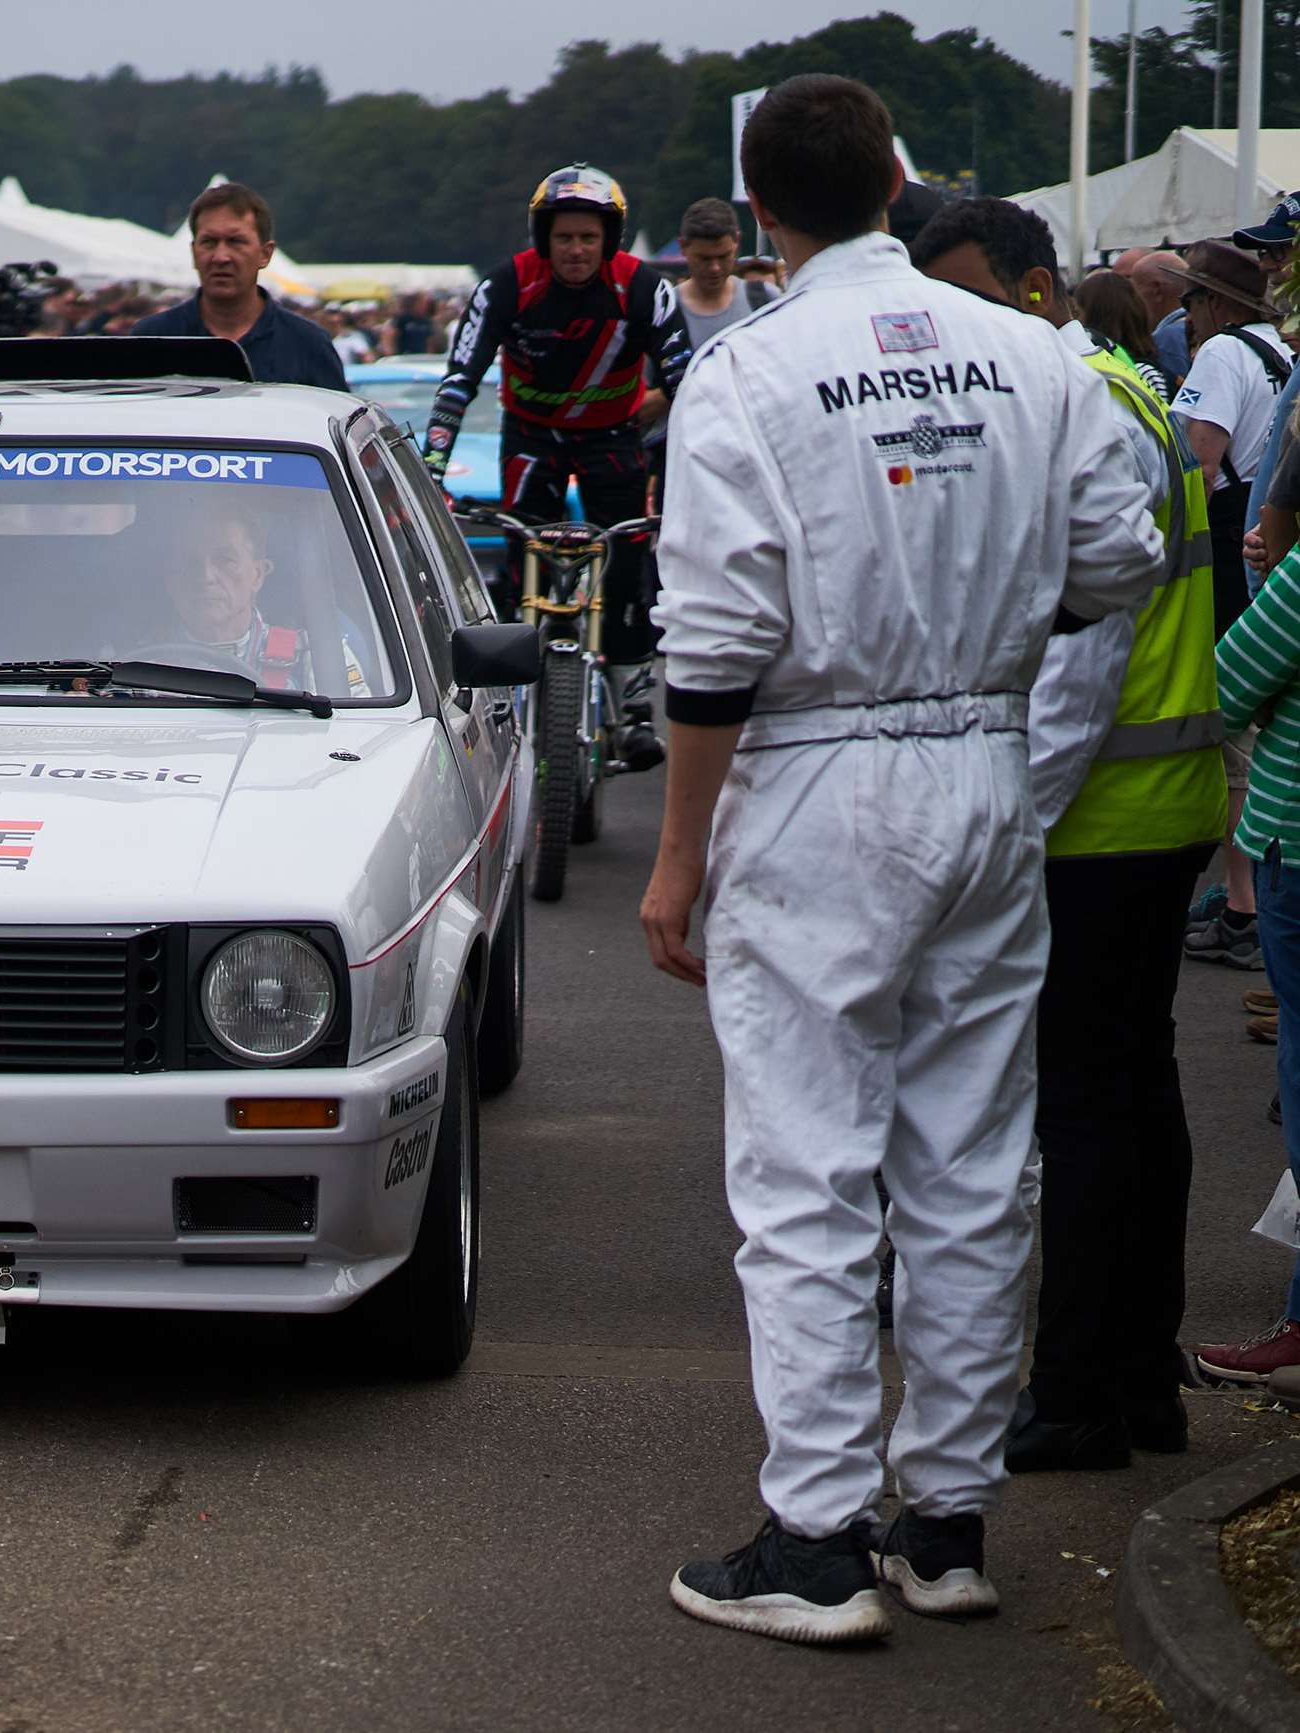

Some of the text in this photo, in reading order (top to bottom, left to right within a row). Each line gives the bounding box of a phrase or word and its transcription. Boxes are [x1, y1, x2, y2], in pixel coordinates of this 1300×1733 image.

[815, 360, 1015, 414] MARSHAL
[389, 1071, 439, 1118] MICHELIN
[384, 1120, 433, 1190] Castrol
